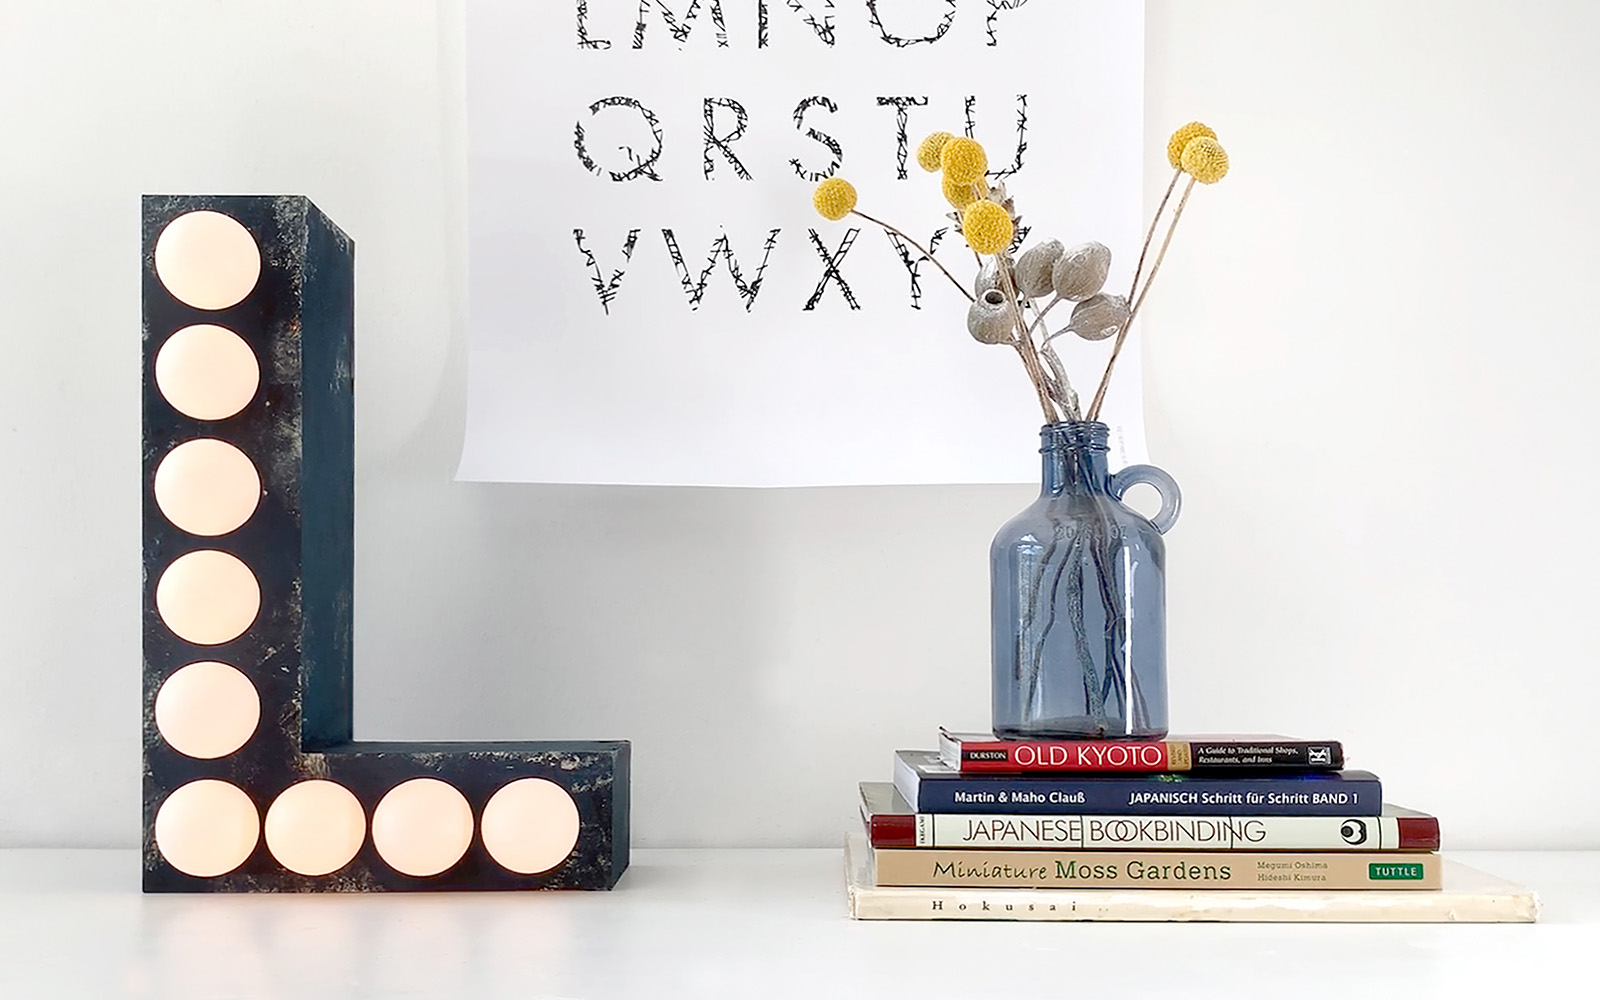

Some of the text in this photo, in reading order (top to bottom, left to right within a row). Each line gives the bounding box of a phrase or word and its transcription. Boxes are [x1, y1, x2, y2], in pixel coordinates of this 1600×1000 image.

[969, 752, 1007, 760] DURSTON
[1014, 745, 1068, 766] OLD
[1077, 745, 1163, 766] KYOTO
[1197, 746, 1299, 756] A Guide to Traditional Shops,
[1198, 755, 1273, 764] Restaurants, and Inns
[954, 791, 1086, 803] Martin & Maho Clauß
[1129, 792, 1358, 805] JAPANISCH Schritt für Schritt BAND 1
[963, 819, 1267, 843] JAPANESE BOOKBINDING
[932, 860, 1232, 880] Miniature Moss Gardens
[1257, 861, 1328, 871] Megumi Oshima
[1375, 866, 1418, 876] TUTTLE
[1257, 873, 1327, 882] Hideshi Kimura
